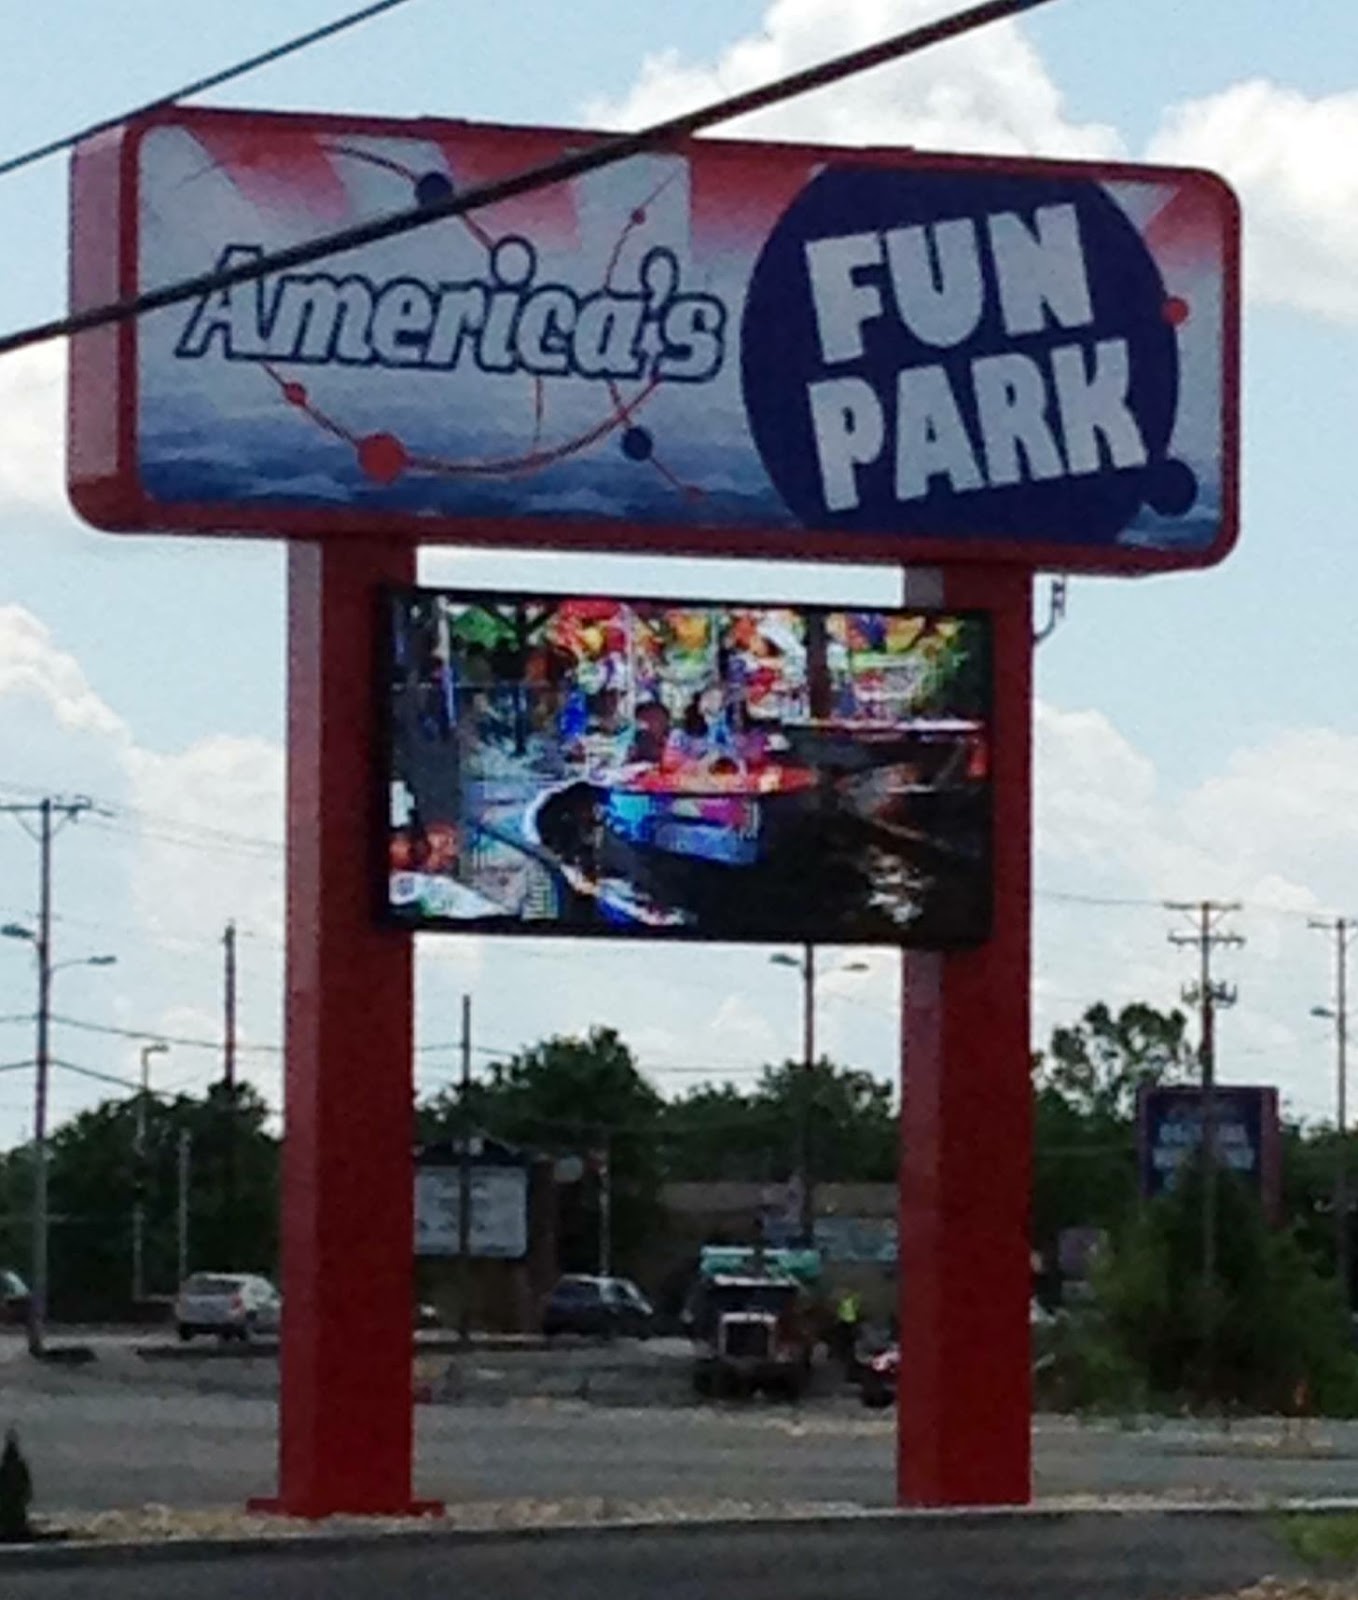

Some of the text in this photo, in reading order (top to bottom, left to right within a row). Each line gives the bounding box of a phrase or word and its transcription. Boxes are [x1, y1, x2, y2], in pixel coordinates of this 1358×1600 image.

[175, 235, 727, 383] America's
[804, 203, 1094, 365] FUN
[806, 338, 1148, 512] PARK
